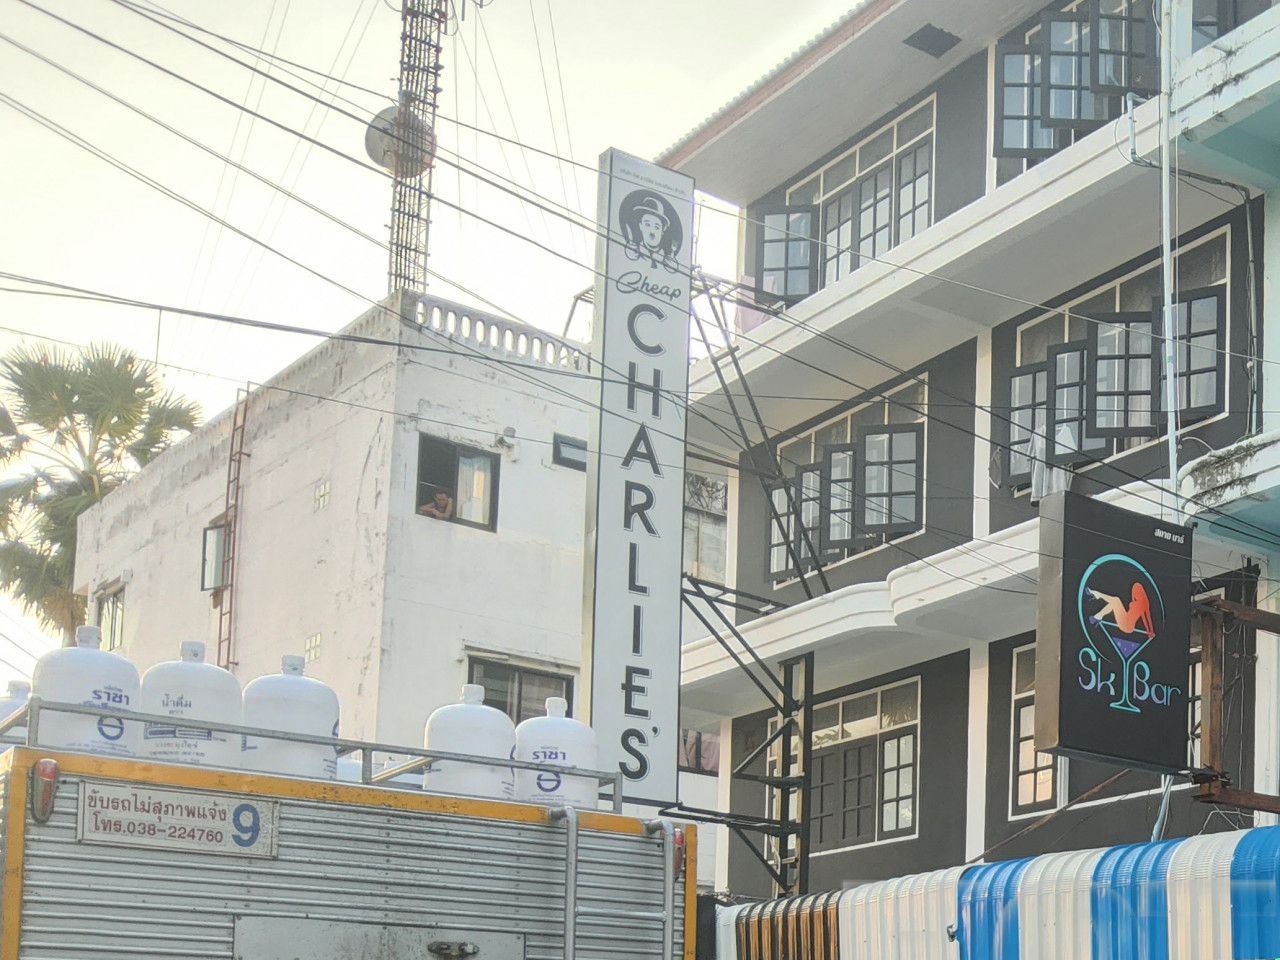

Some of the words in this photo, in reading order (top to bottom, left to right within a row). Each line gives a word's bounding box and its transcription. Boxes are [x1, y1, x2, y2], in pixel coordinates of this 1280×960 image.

[616, 271, 682, 301] Cheap
[618, 302, 668, 782] CHARLIE'S
[1133, 661, 1182, 706] Bar
[87, 789, 227, 822] ขับรถไม่สุภาพแจ้ง
[231, 803, 261, 847] 9
[92, 811, 223, 843] โทร.038-224760
